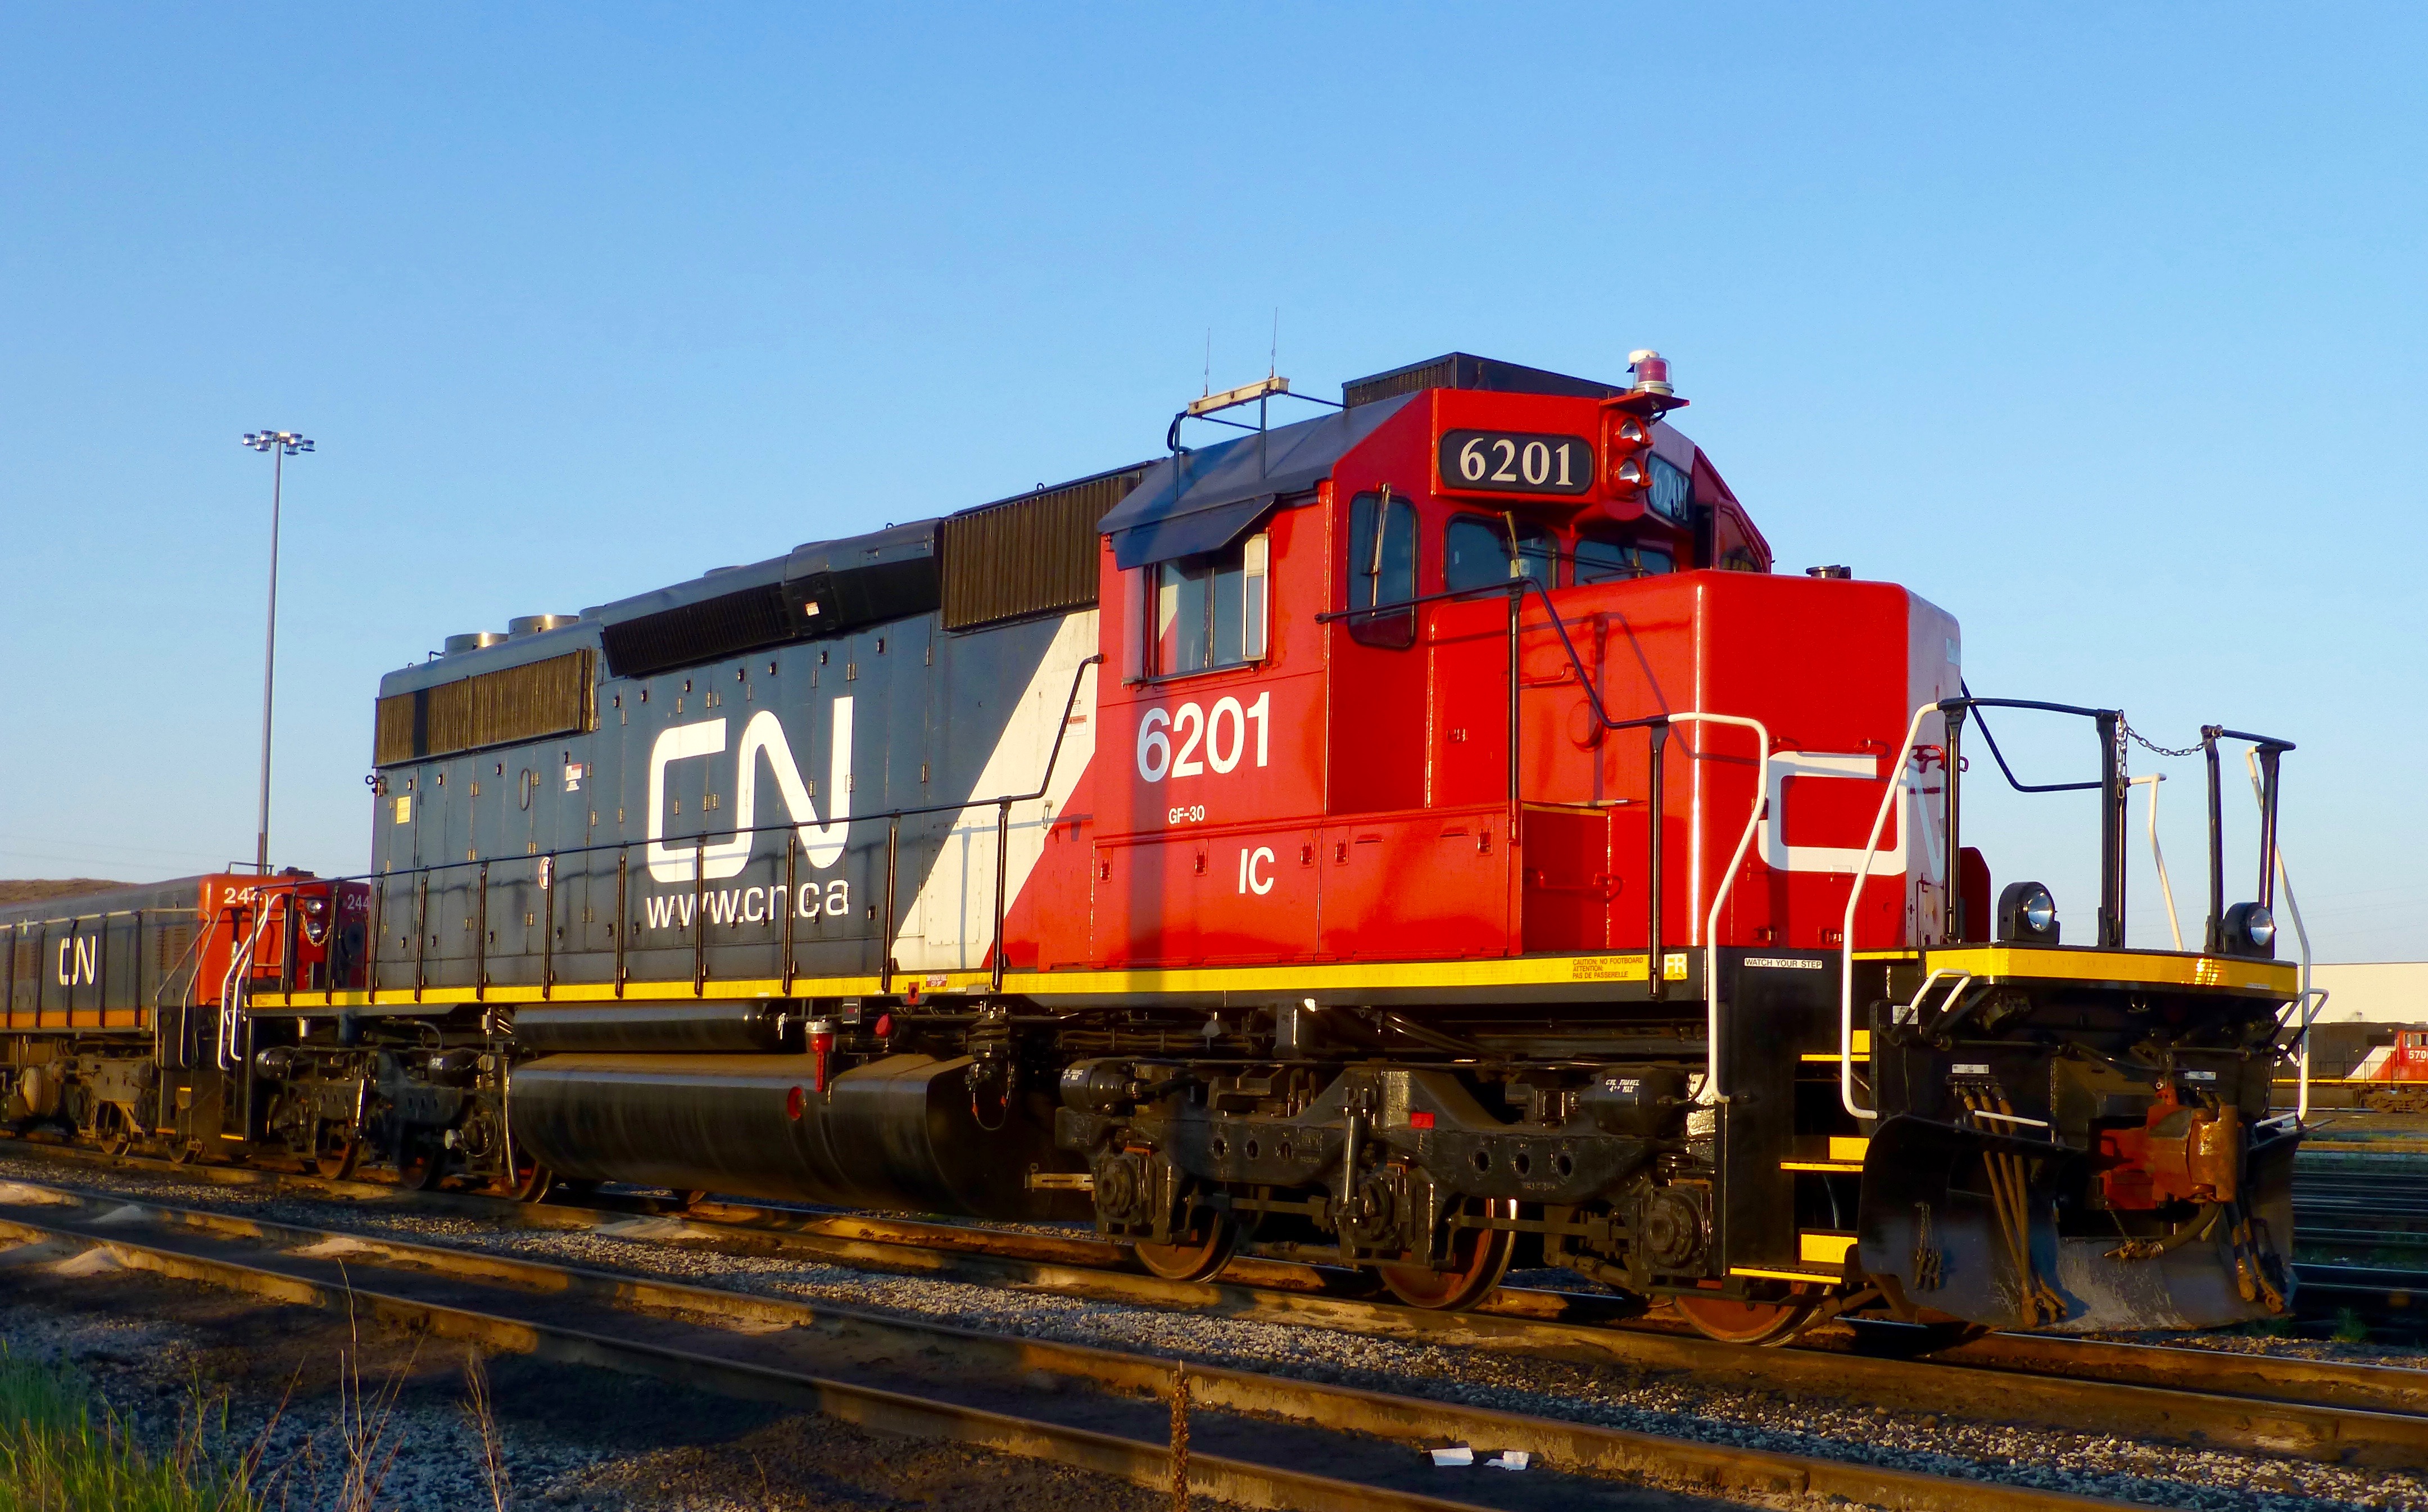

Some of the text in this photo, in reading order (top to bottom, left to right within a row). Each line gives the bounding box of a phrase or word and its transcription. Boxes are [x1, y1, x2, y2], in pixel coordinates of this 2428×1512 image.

[1460, 437, 1573, 487] 6201
[1136, 691, 1270, 782] 6201
[648, 696, 854, 882] CN
[1168, 804, 1205, 825] GF-30
[1239, 846, 1275, 895] IC
[646, 879, 849, 929] www.cn.ca
[59, 935, 96, 985] CN
[1664, 953, 1687, 974] FR
[2408, 1050, 2428, 1060] 570
